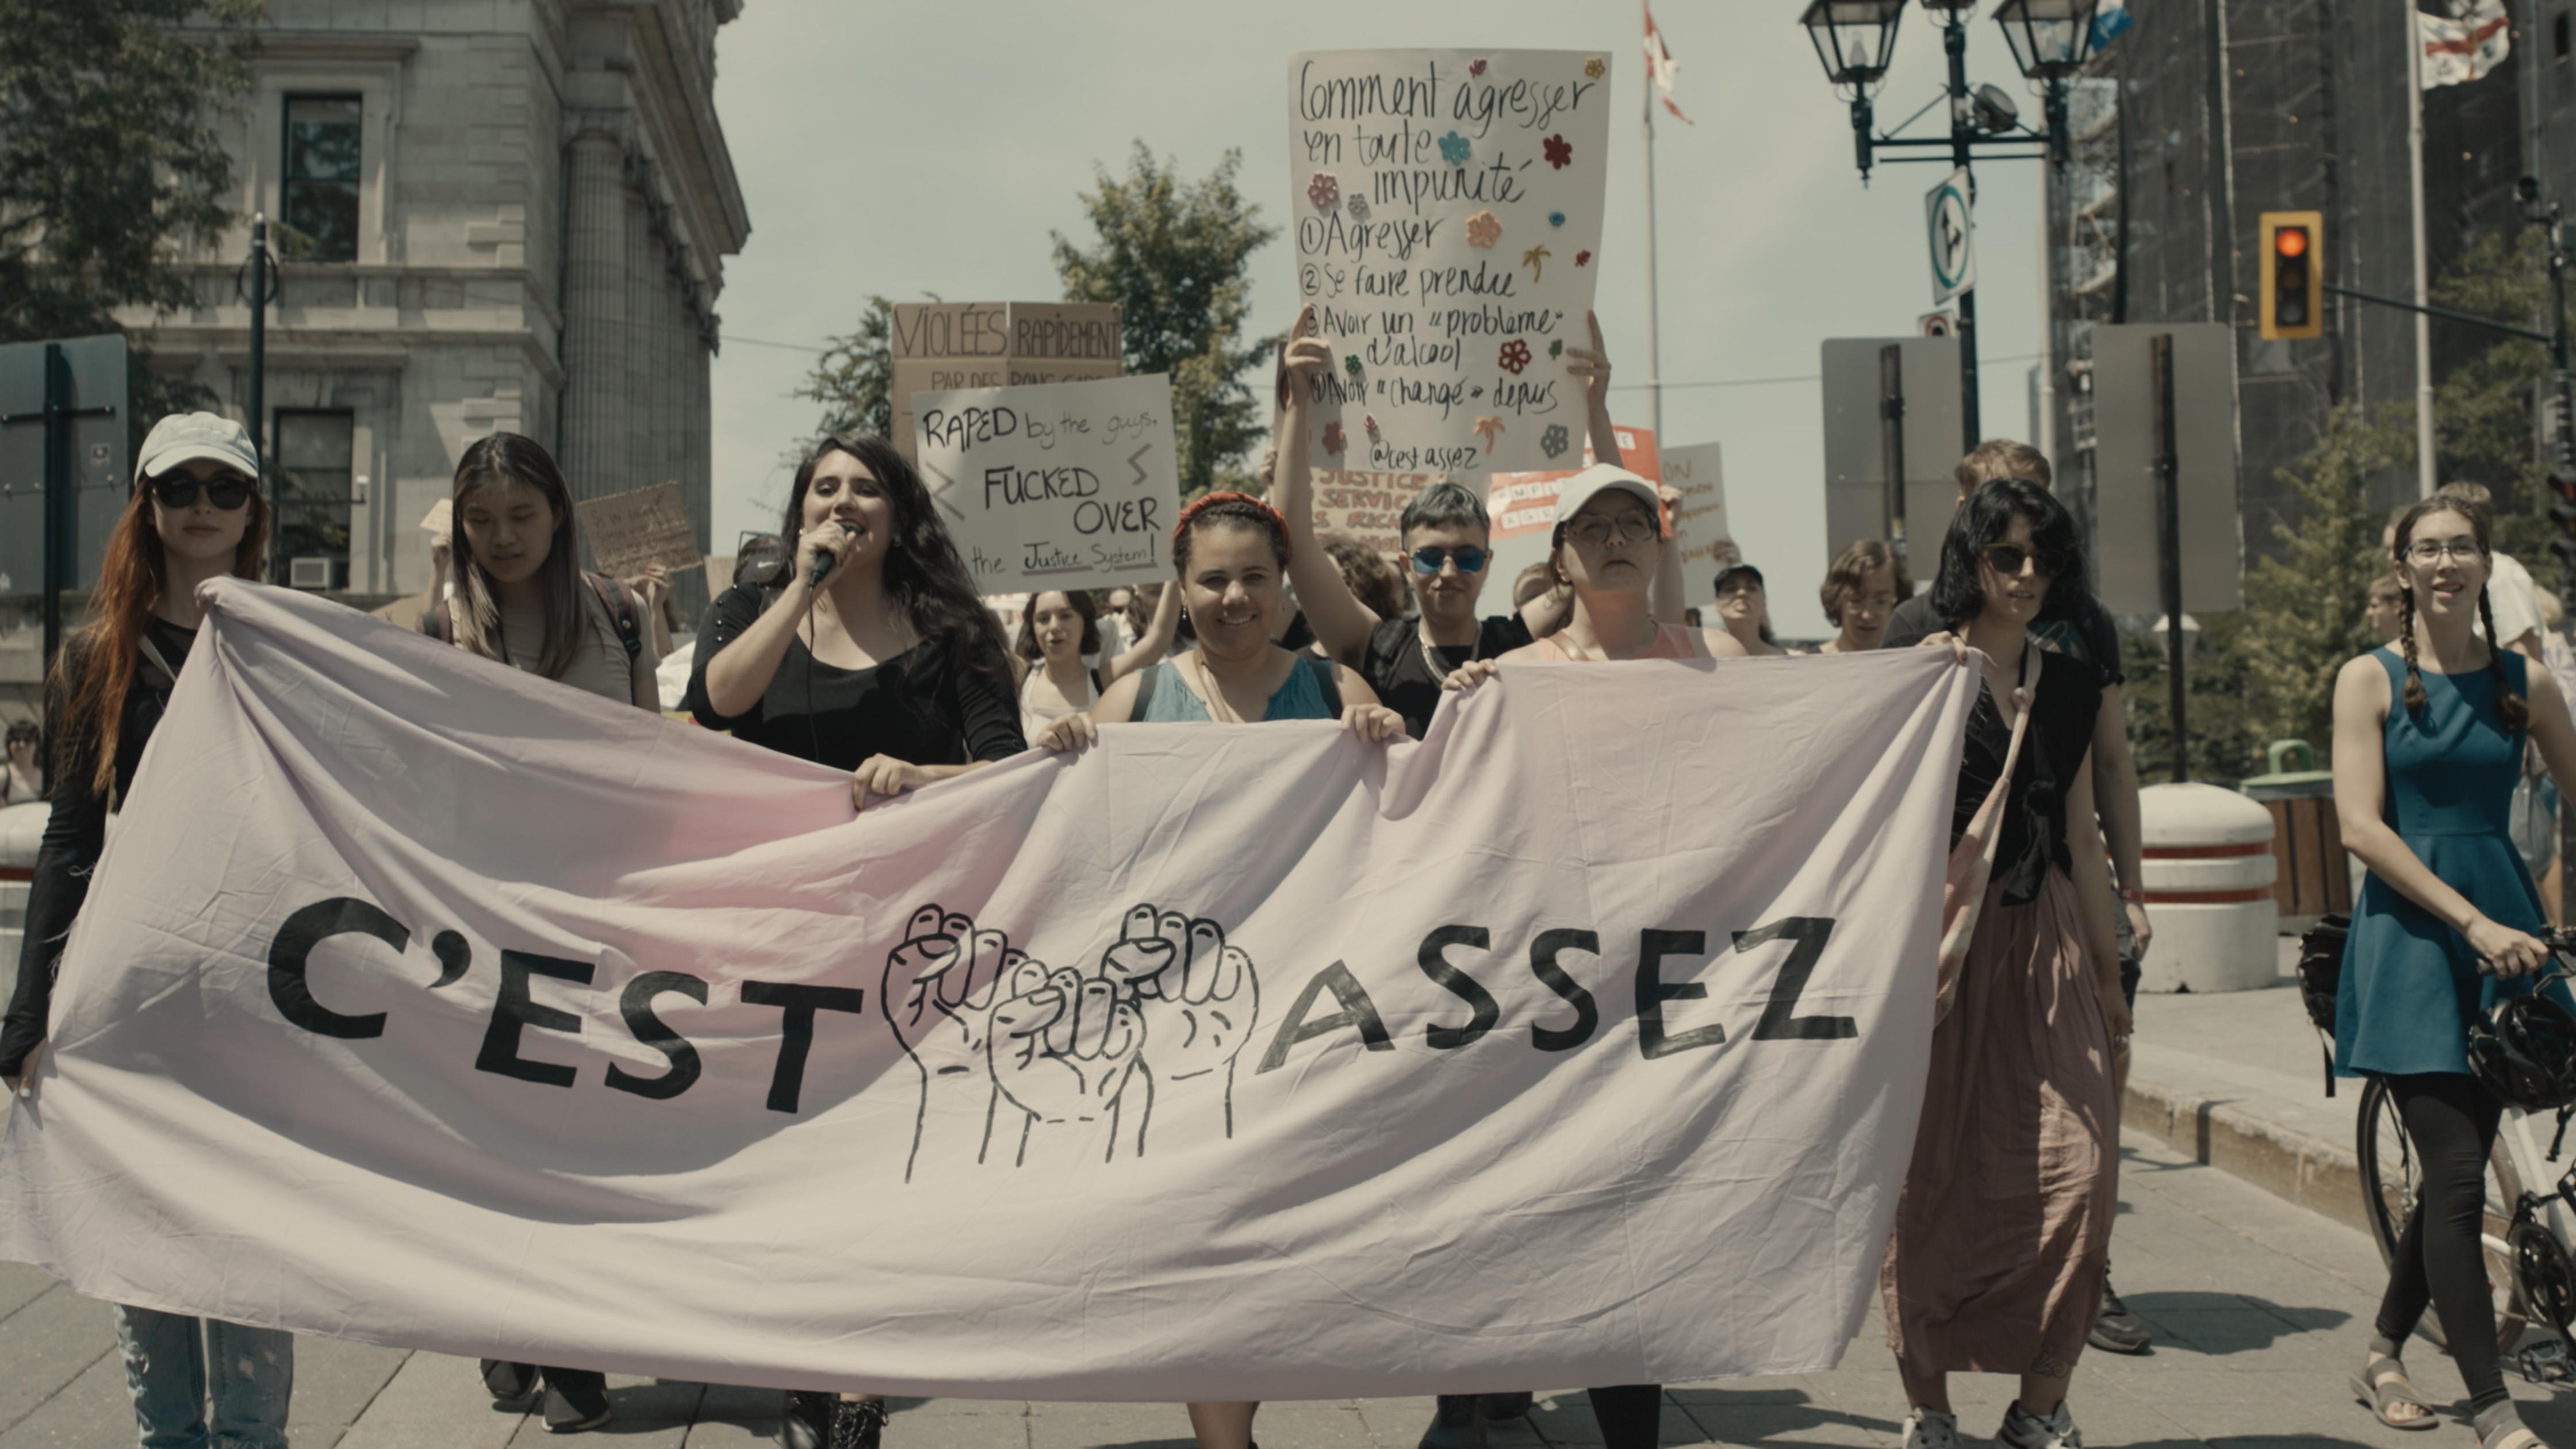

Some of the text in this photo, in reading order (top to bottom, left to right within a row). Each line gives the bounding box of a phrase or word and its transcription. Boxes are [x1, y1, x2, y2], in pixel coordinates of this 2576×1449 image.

[1300, 60, 1595, 139] Comment agresser
[1304, 119, 1432, 167] en toute
[1374, 152, 1532, 215] impunité
[1325, 211, 1445, 263] Agresser
[1324, 263, 1345, 298] Se
[1354, 267, 1410, 297] faire
[1324, 304, 1373, 336] Avoir
[1382, 311, 1413, 335] un
[1327, 371, 1369, 407] Avoir
[1493, 377, 1557, 416] depuis
[923, 407, 1017, 453] RAPED
[1025, 412, 1056, 450] by
[1060, 412, 1090, 433] the
[984, 465, 1099, 511] FUCKED
[1318, 489, 1408, 511] SERVIC
[1319, 469, 1427, 490] JUSTICE
[1074, 497, 1160, 534] OVER
[972, 532, 1155, 574] the Justice System!
[266, 896, 1859, 1114] C'EST ASSEZ
